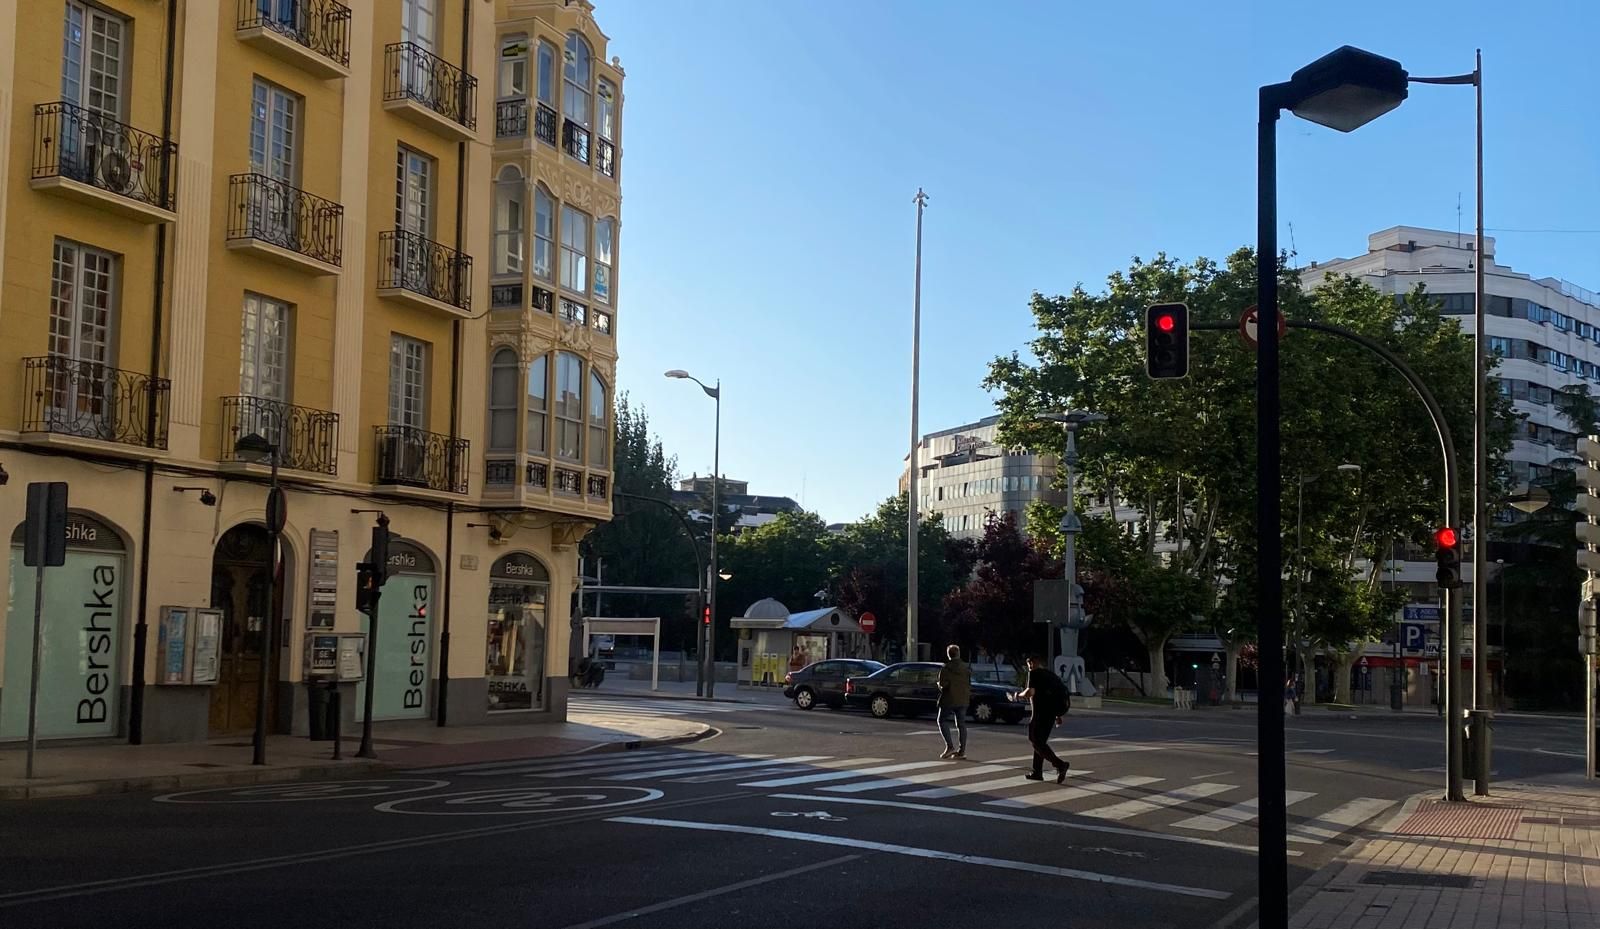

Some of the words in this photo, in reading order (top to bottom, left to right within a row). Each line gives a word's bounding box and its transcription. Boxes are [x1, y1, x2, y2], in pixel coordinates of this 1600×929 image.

[65, 522, 97, 541] shka
[386, 552, 416, 567] ershka
[505, 561, 534, 576] Bershka
[76, 565, 115, 724] Bershka
[1406, 625, 1421, 647] P
[403, 584, 427, 709] Bershka
[488, 680, 527, 692] RSHKA
